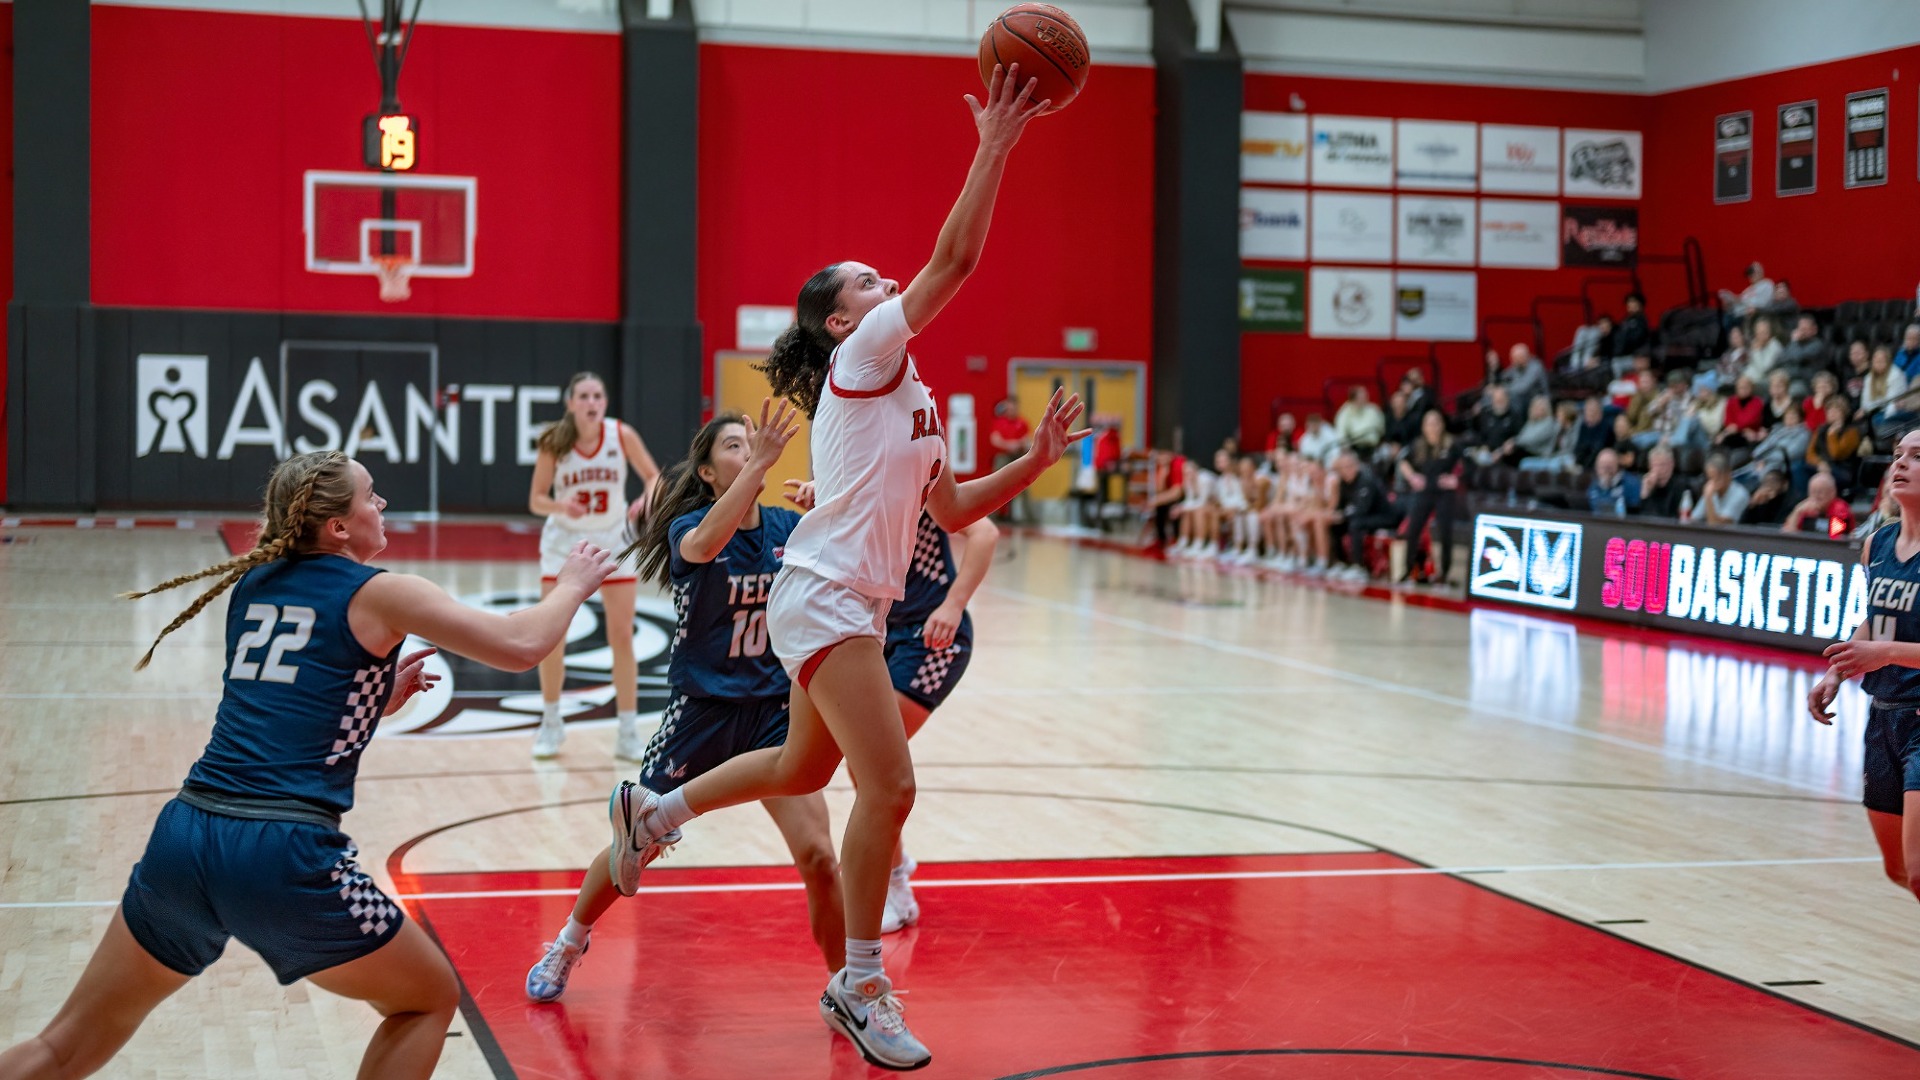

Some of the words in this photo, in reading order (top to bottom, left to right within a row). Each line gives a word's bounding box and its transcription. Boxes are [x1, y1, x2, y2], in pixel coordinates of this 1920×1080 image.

[216, 355, 562, 467] ASANTE
[911, 406, 945, 442] RA
[563, 467, 619, 488] RAIDERS
[727, 572, 777, 606] TEC
[1867, 577, 1920, 613] TECH
[229, 603, 316, 684] 22
[729, 609, 767, 658] 10
